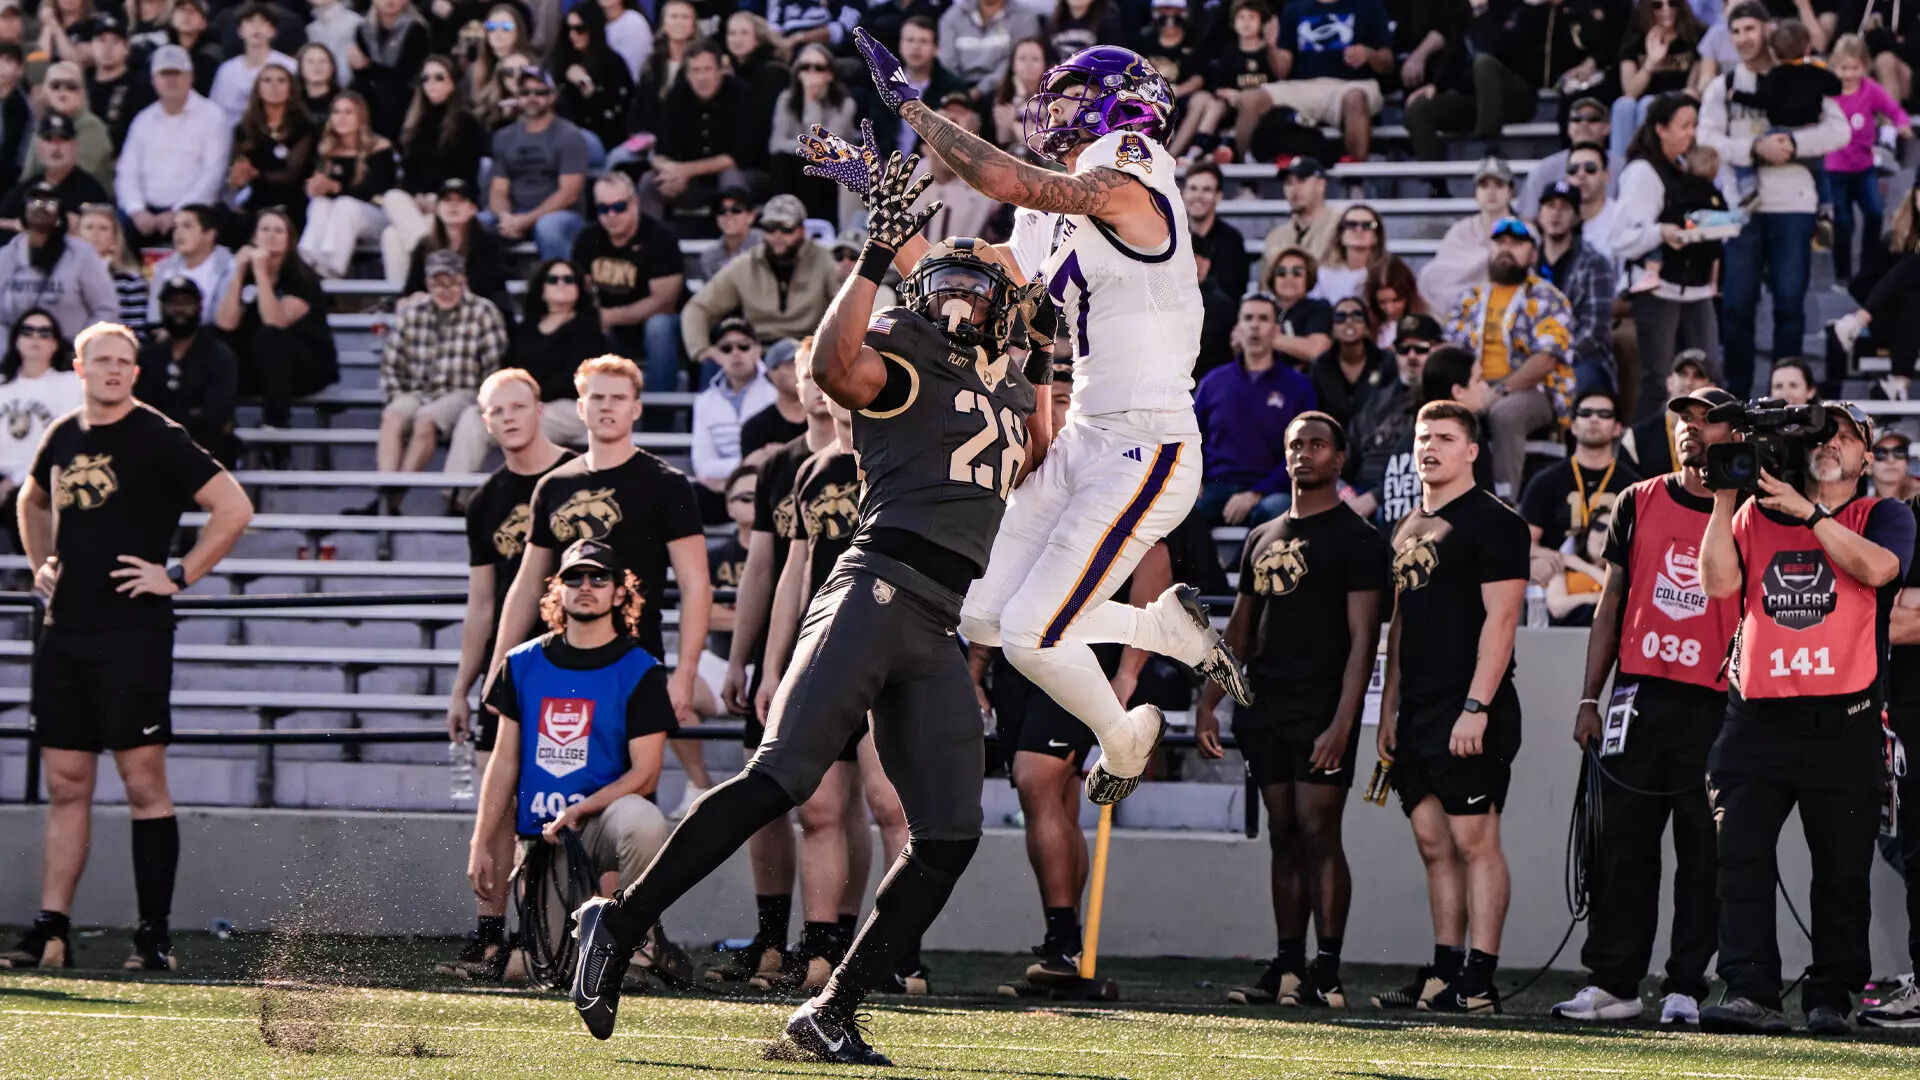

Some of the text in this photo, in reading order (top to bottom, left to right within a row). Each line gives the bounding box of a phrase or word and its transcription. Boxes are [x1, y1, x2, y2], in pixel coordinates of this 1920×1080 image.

[947, 352, 969, 369] PLATT
[949, 388, 1026, 502] 28
[1655, 587, 1706, 608] COLLEGE
[1767, 593, 1831, 608] COLLEGE
[1775, 610, 1822, 620] FOOTBALL
[1641, 631, 1702, 667] 038
[1769, 647, 1836, 677] 141
[538, 748, 585, 760] COLLEGE
